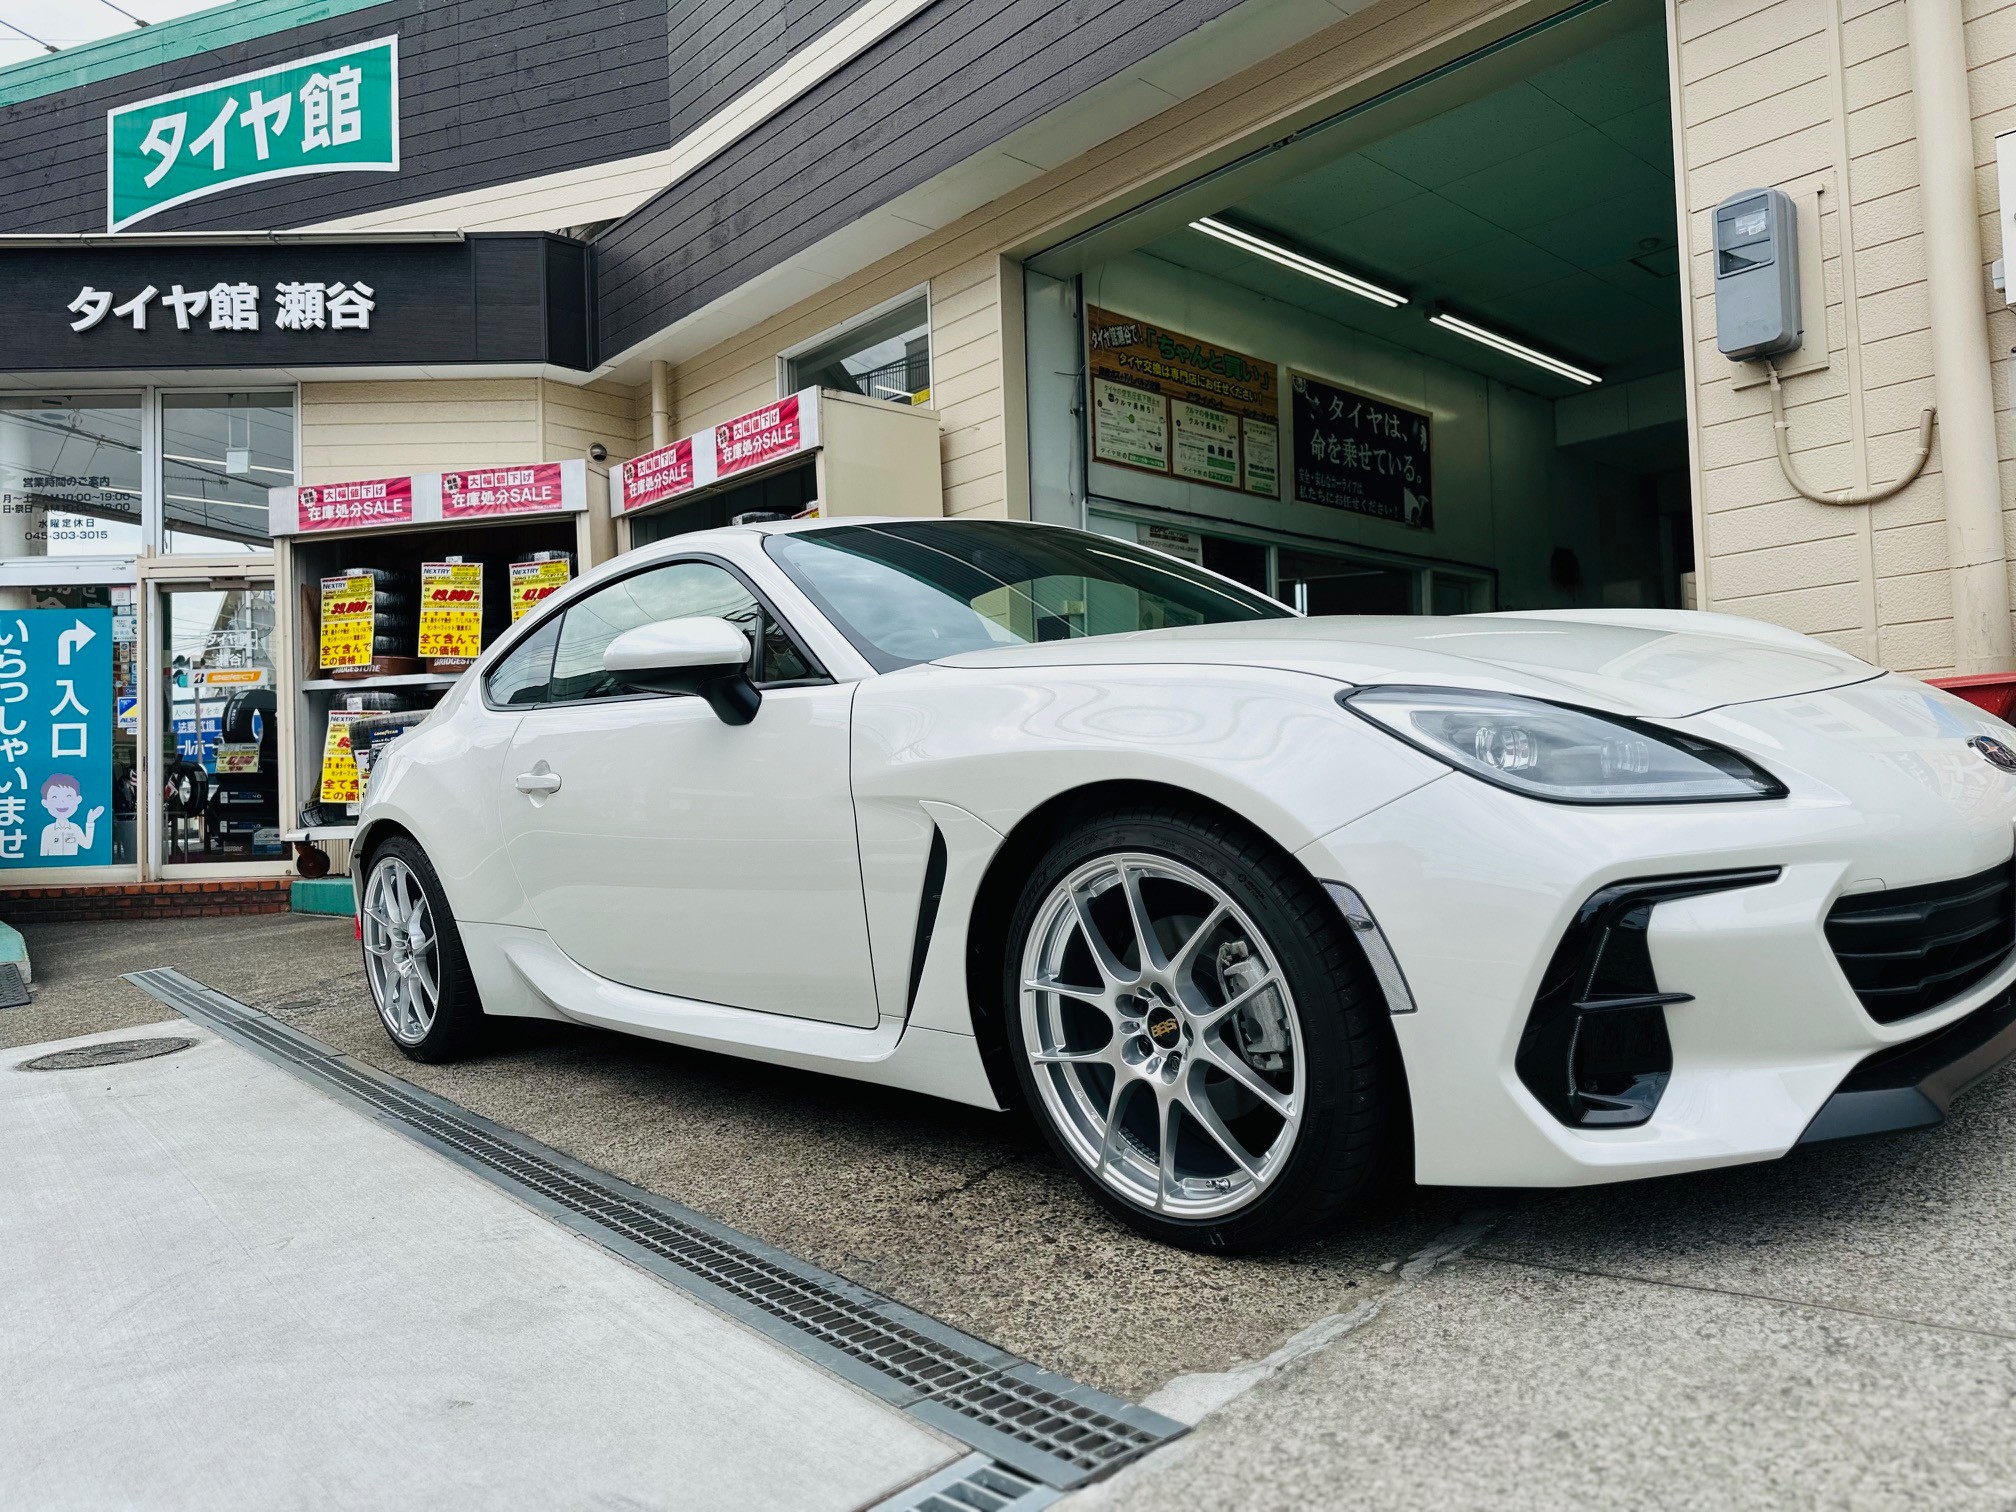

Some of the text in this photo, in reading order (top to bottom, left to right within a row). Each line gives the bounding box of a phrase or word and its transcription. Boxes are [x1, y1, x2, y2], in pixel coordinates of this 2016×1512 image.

[139, 65, 363, 189] タイヤ館
[67, 280, 376, 333] タイヤ館 瀬谷
[1146, 328, 1269, 390] 「ちゃんと買い」
[1118, 353, 1263, 406] タイヤ交換は専門店にお任せください！
[1329, 395, 1408, 443] タイヤは、
[723, 423, 794, 464] 在庫処分SALE
[1310, 428, 1422, 484] 命を乗せている。
[23, 476, 110, 489] 営業時間のご案内
[468, 470, 534, 489] 大幅値下げ
[630, 463, 688, 498] 在庫処分SALE
[324, 484, 386, 502] 大幅値下げ
[452, 486, 552, 508] 在庫処分SALE
[308, 499, 403, 521] 在庫処分SALE
[38, 518, 95, 530] 水曜定休日
[25, 531, 108, 541] 045-303-3015
[512, 567, 540, 576] NEXTRY
[322, 583, 346, 591] NEXTRY
[322, 643, 372, 656] 全て含んで
[420, 633, 480, 645] 全て含んで
[321, 654, 371, 666] この価格！！
[420, 645, 480, 656] この価格！！
[50, 679, 90, 757] 入口
[0, 617, 29, 860] いらっしゃいませ
[1151, 1018, 1178, 1039] BBS
